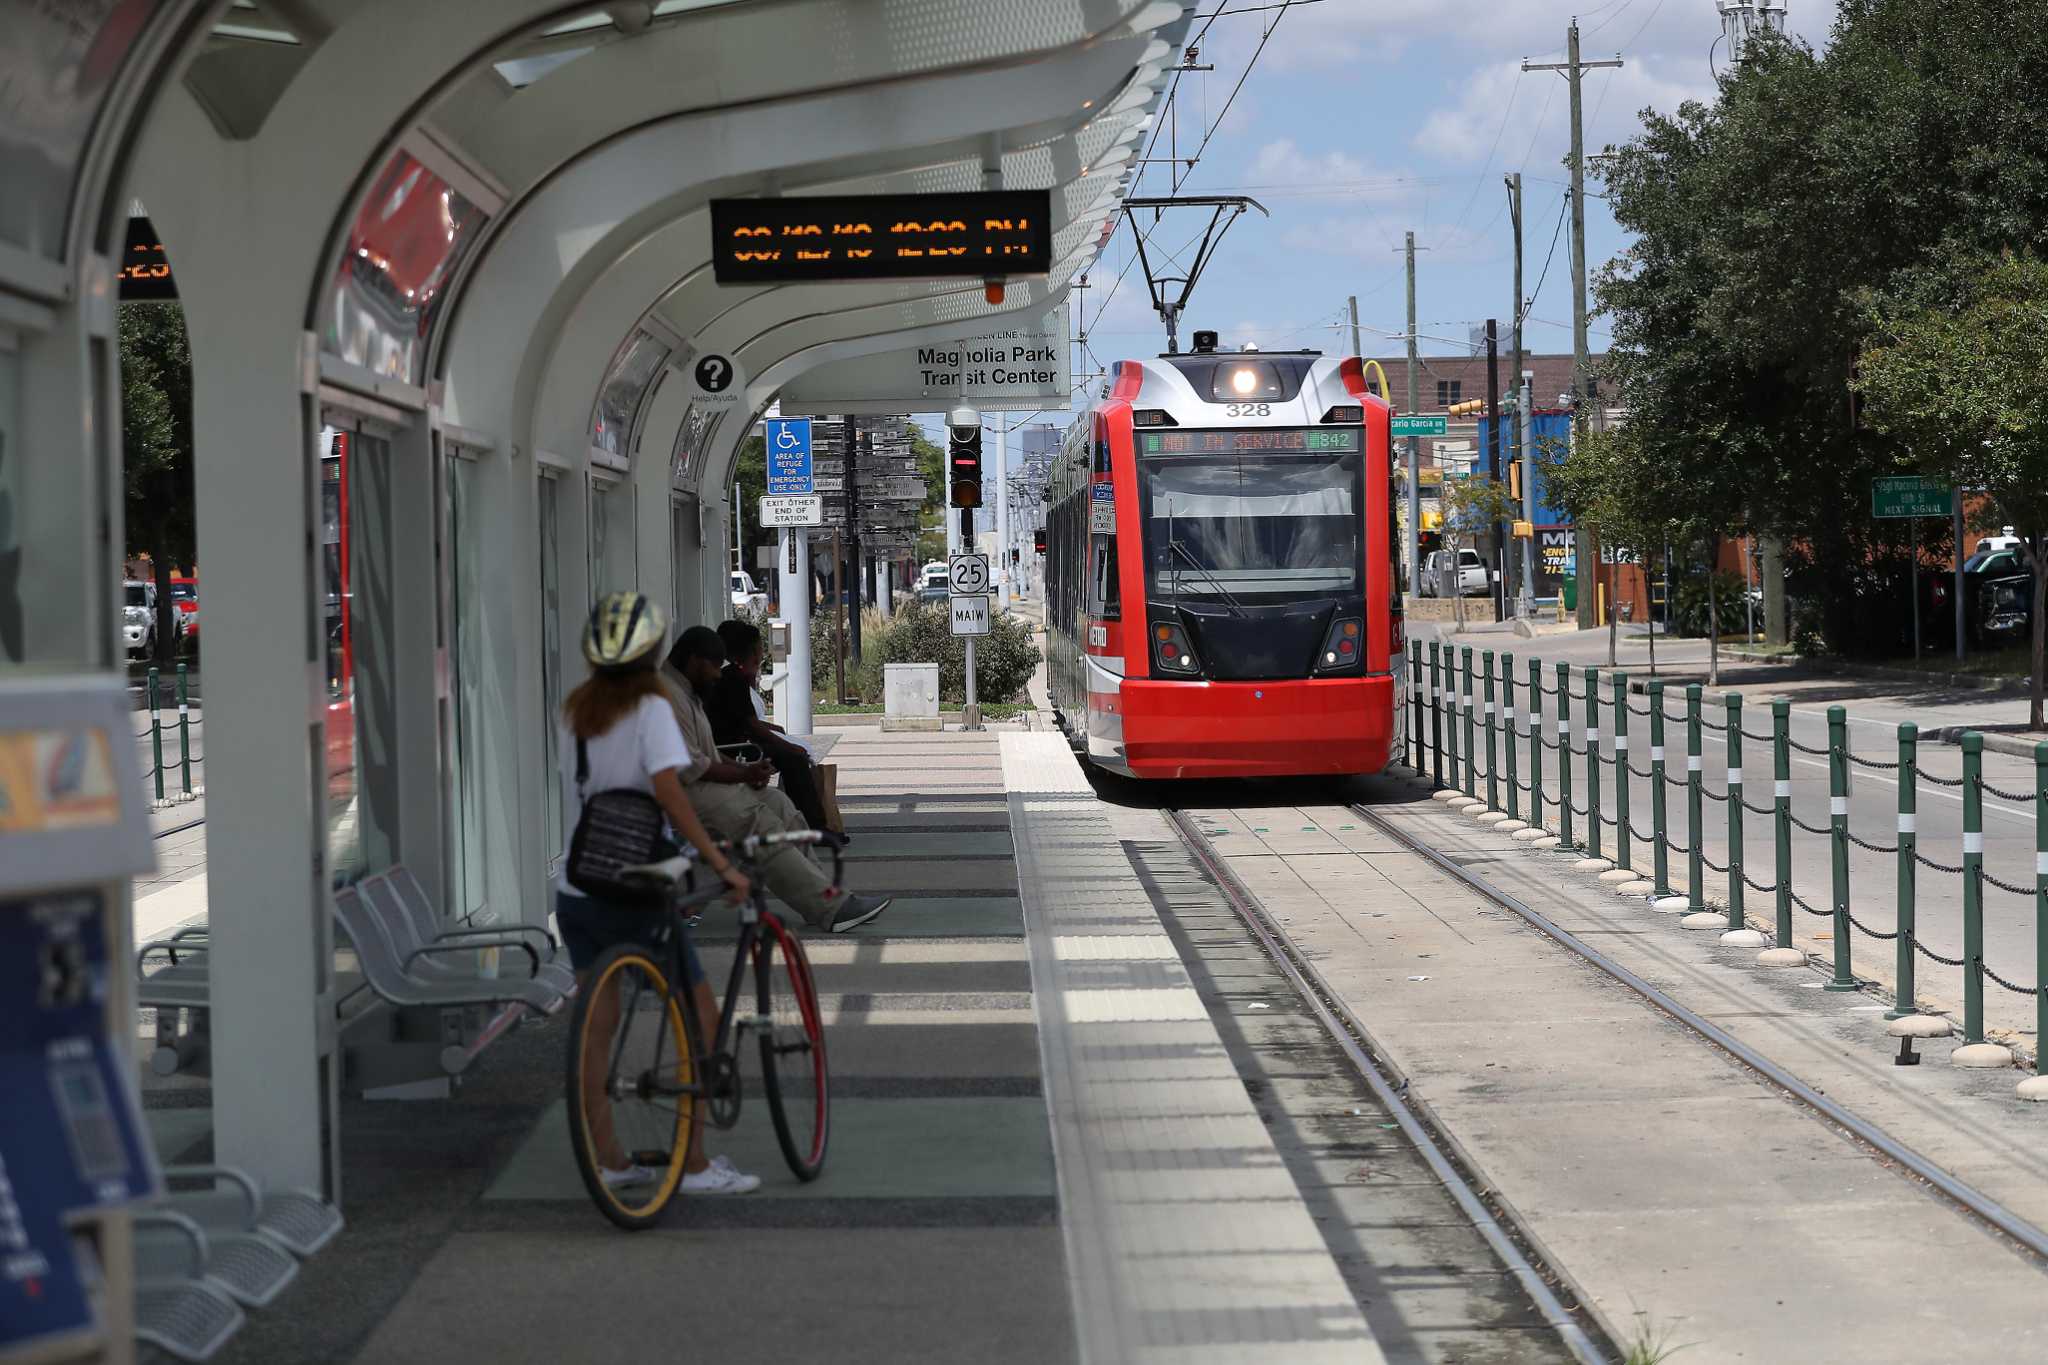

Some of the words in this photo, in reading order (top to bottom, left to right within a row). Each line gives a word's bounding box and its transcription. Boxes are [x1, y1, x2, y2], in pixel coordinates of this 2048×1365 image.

[997, 330, 1017, 339] LINE
[1012, 345, 1057, 362] Park
[991, 368, 1057, 385] Center
[1226, 403, 1271, 418] 328
[1163, 434, 1192, 450] NOT
[1203, 434, 1224, 450] IN
[1234, 433, 1303, 450] SERVICE
[1884, 505, 1905, 514] NEXT
[1911, 504, 1942, 513] SIGNAL
[956, 564, 982, 584] 25
